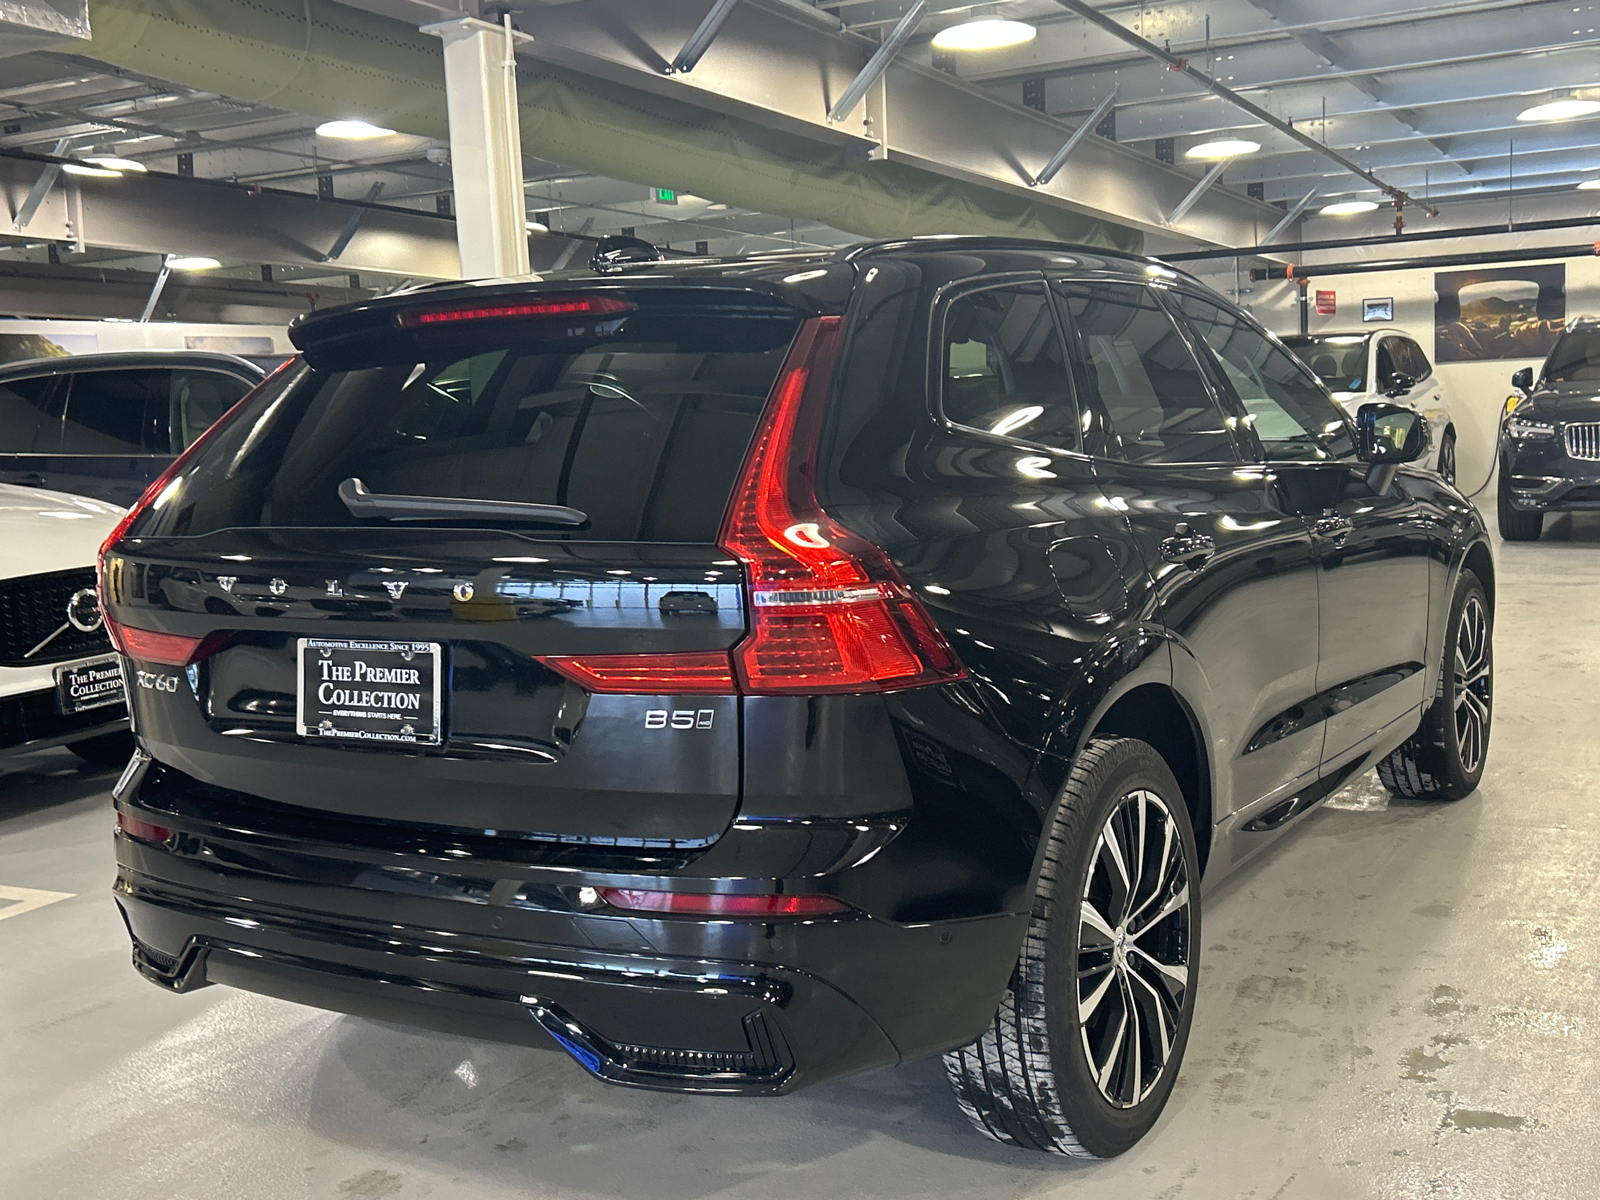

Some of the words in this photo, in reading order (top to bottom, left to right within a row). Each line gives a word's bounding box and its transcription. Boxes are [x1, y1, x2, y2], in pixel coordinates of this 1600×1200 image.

[217, 576, 475, 602] VOLVO
[411, 643, 430, 652] 1995
[69, 674, 89, 685] THE
[89, 668, 121, 681] PREMIE
[136, 670, 180, 692] XC60
[318, 660, 352, 681] THE
[353, 661, 421, 684] PREMIER
[318, 682, 421, 709] COLLECTION
[645, 709, 695, 729] B5
